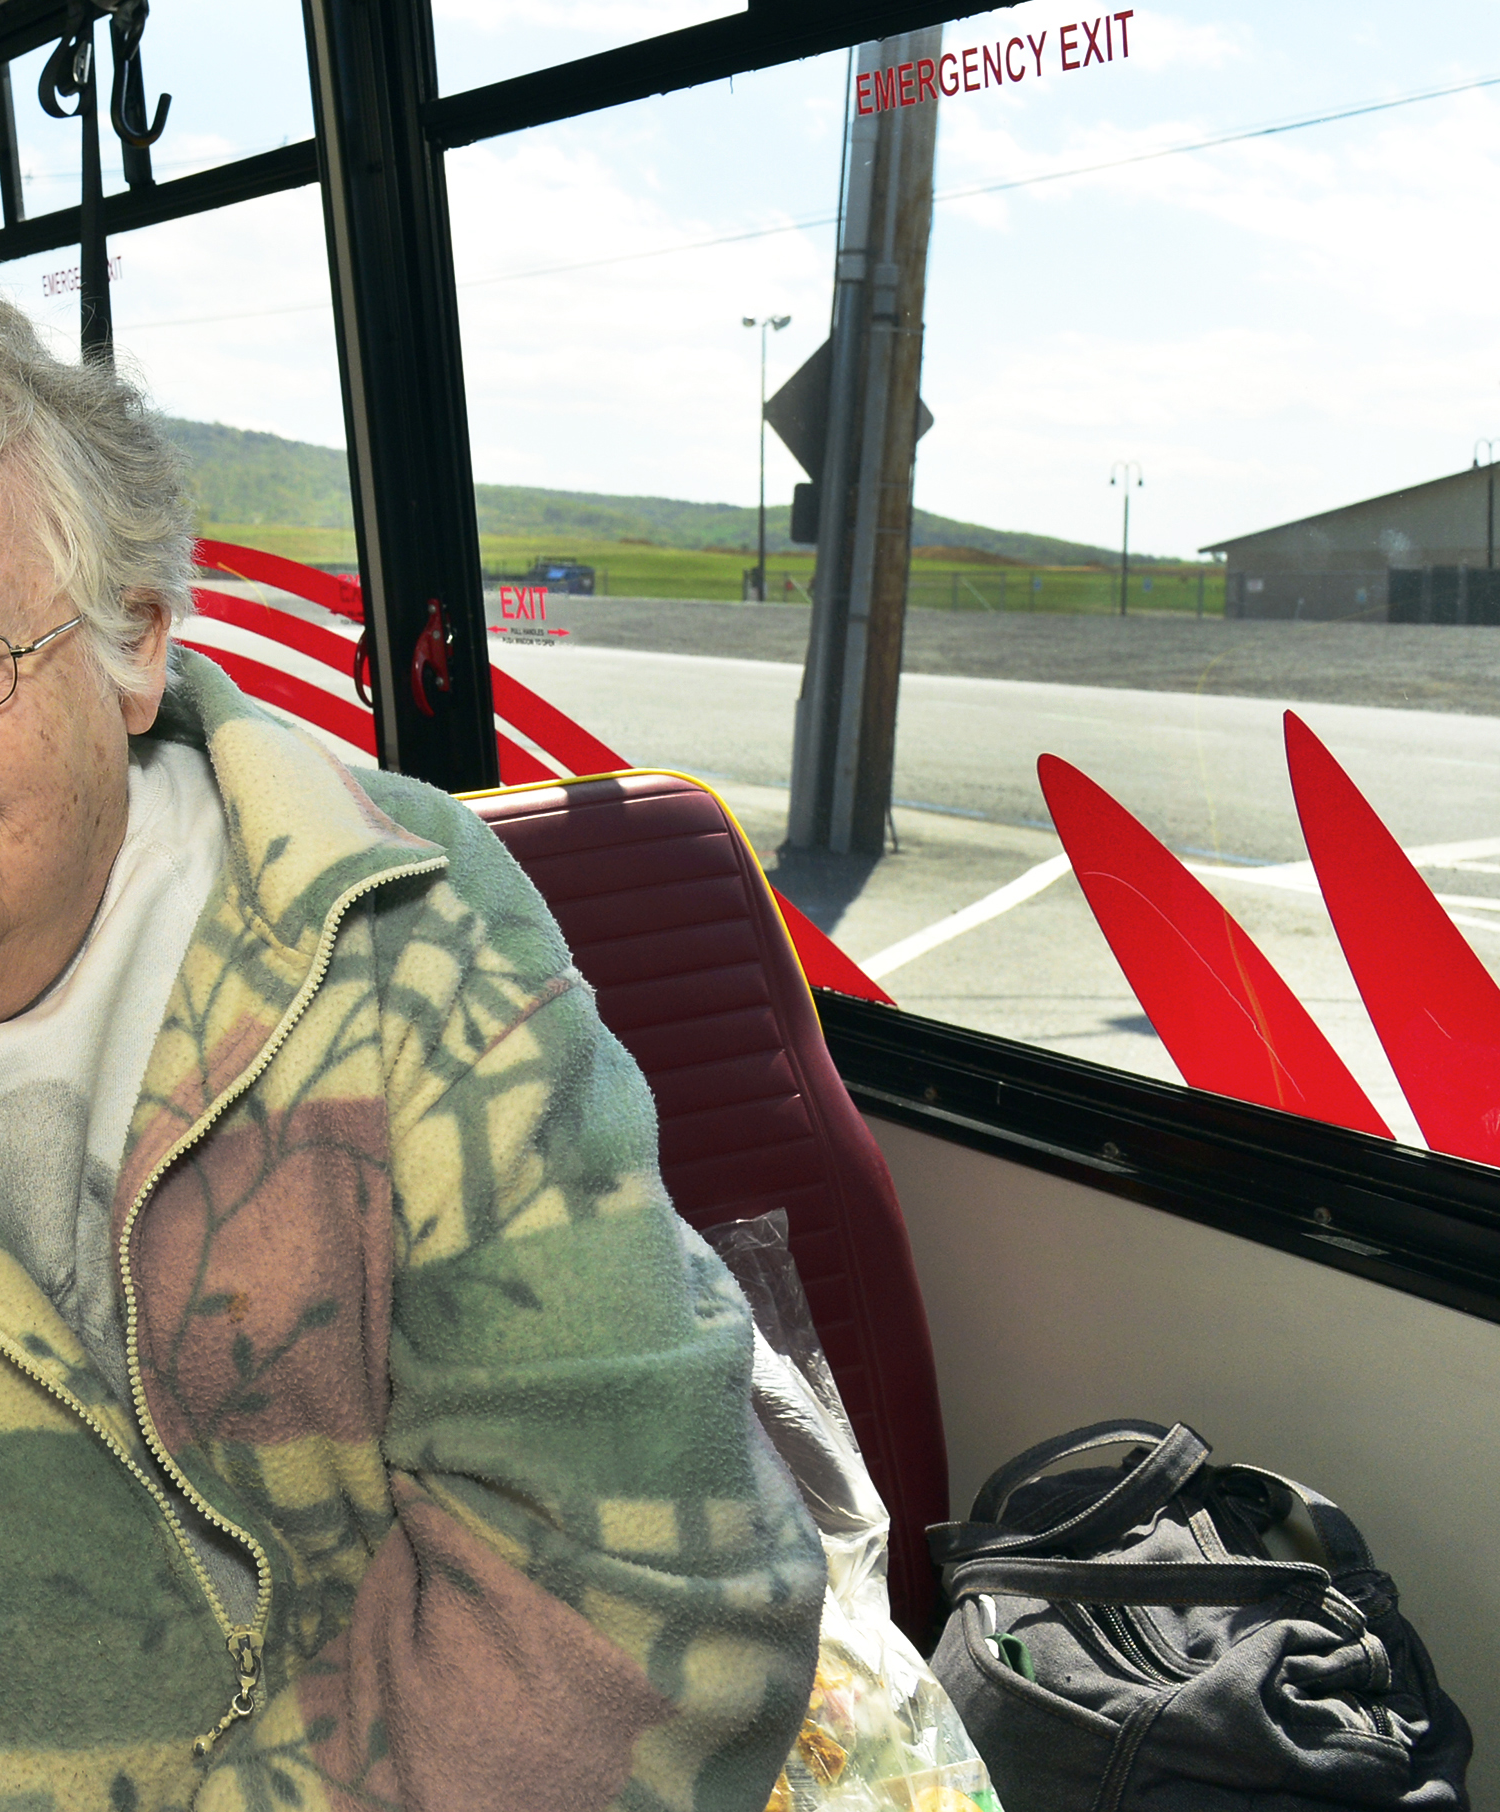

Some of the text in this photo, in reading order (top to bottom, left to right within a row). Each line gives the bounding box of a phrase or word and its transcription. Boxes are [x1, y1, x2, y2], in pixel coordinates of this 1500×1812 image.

[855, 9, 1134, 116] EMERGENCY EXIT
[42, 266, 81, 296] EMERGE
[500, 586, 548, 620] EXIT
